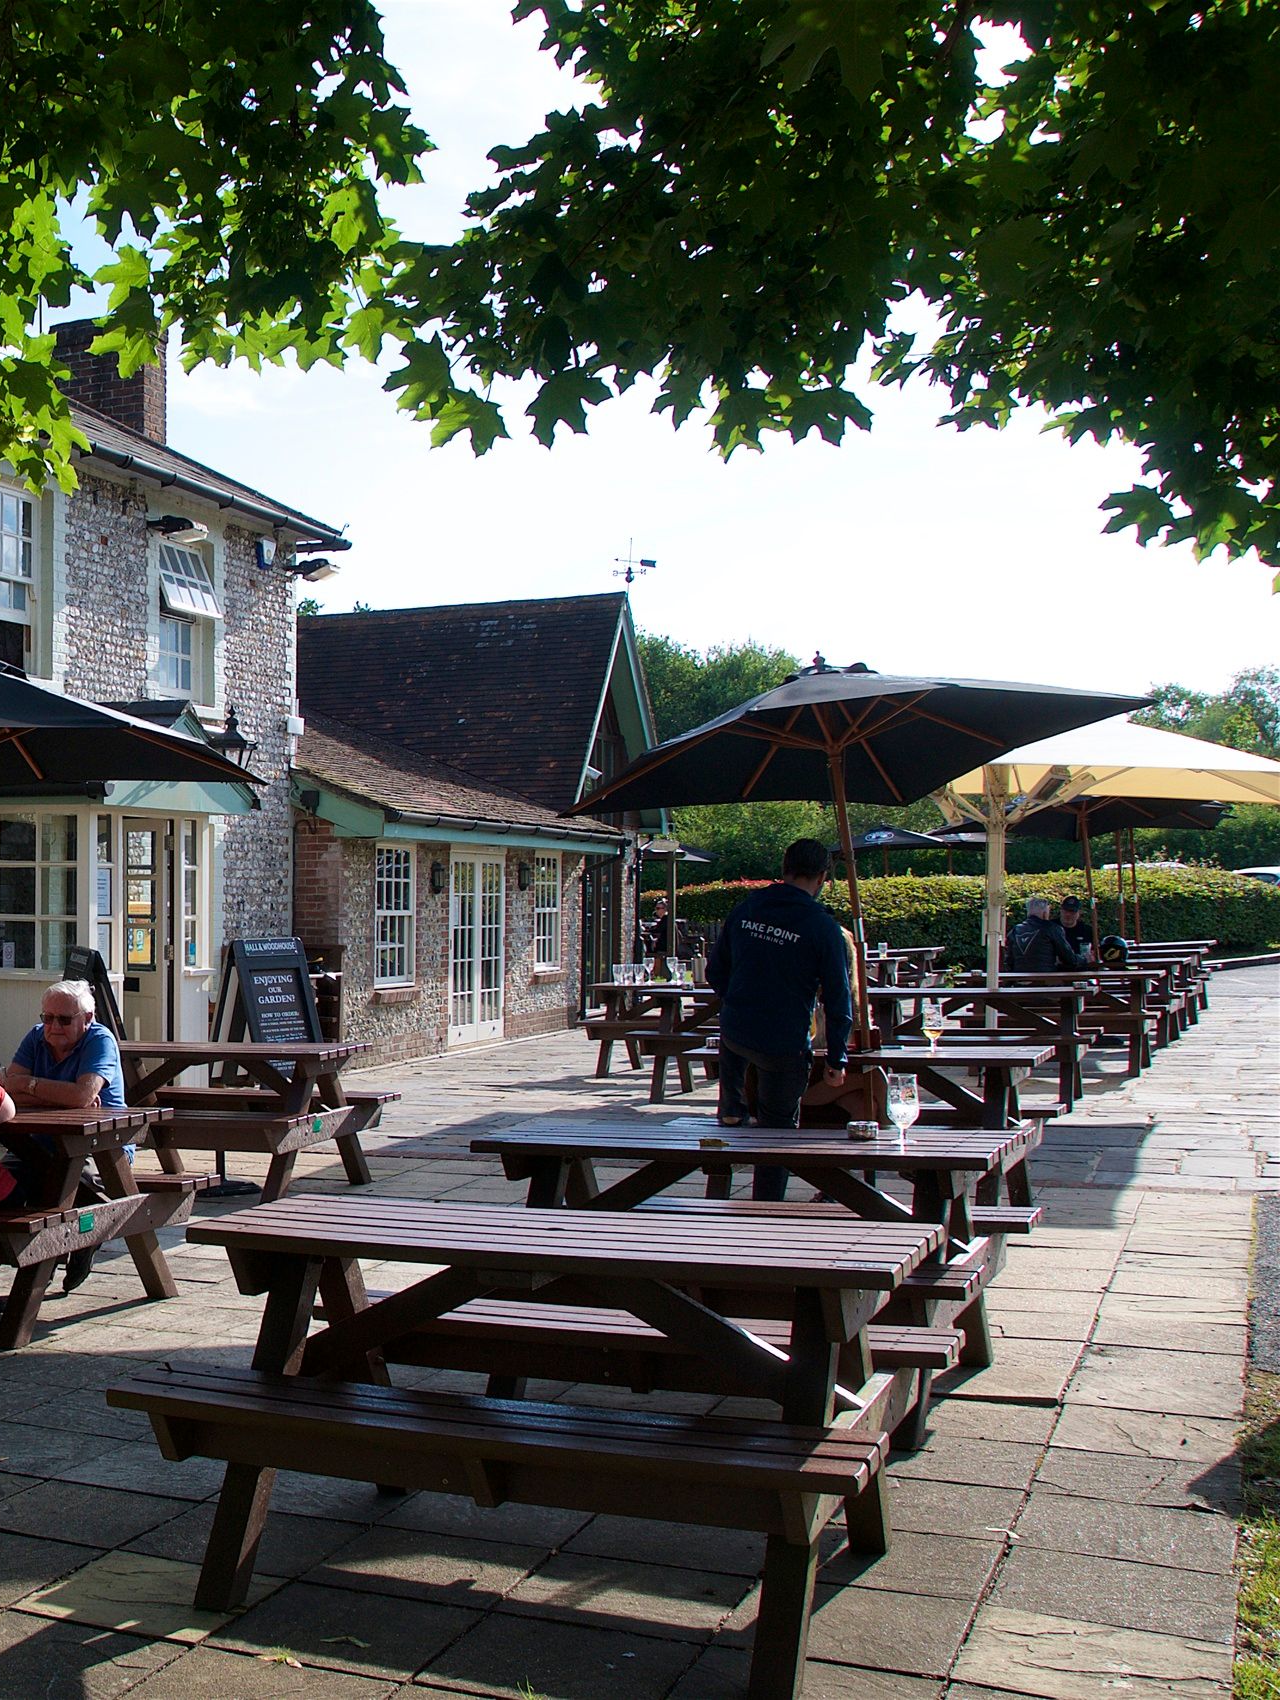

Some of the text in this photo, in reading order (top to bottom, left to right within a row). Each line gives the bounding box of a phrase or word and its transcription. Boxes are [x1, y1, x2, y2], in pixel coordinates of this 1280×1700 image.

[741, 920, 801, 943] TAKE POINT
[750, 932, 784, 946] TRAINING
[253, 975, 293, 985] ENJOYING
[267, 986, 282, 994] OUR
[258, 994, 296, 1005] GARDEN?
